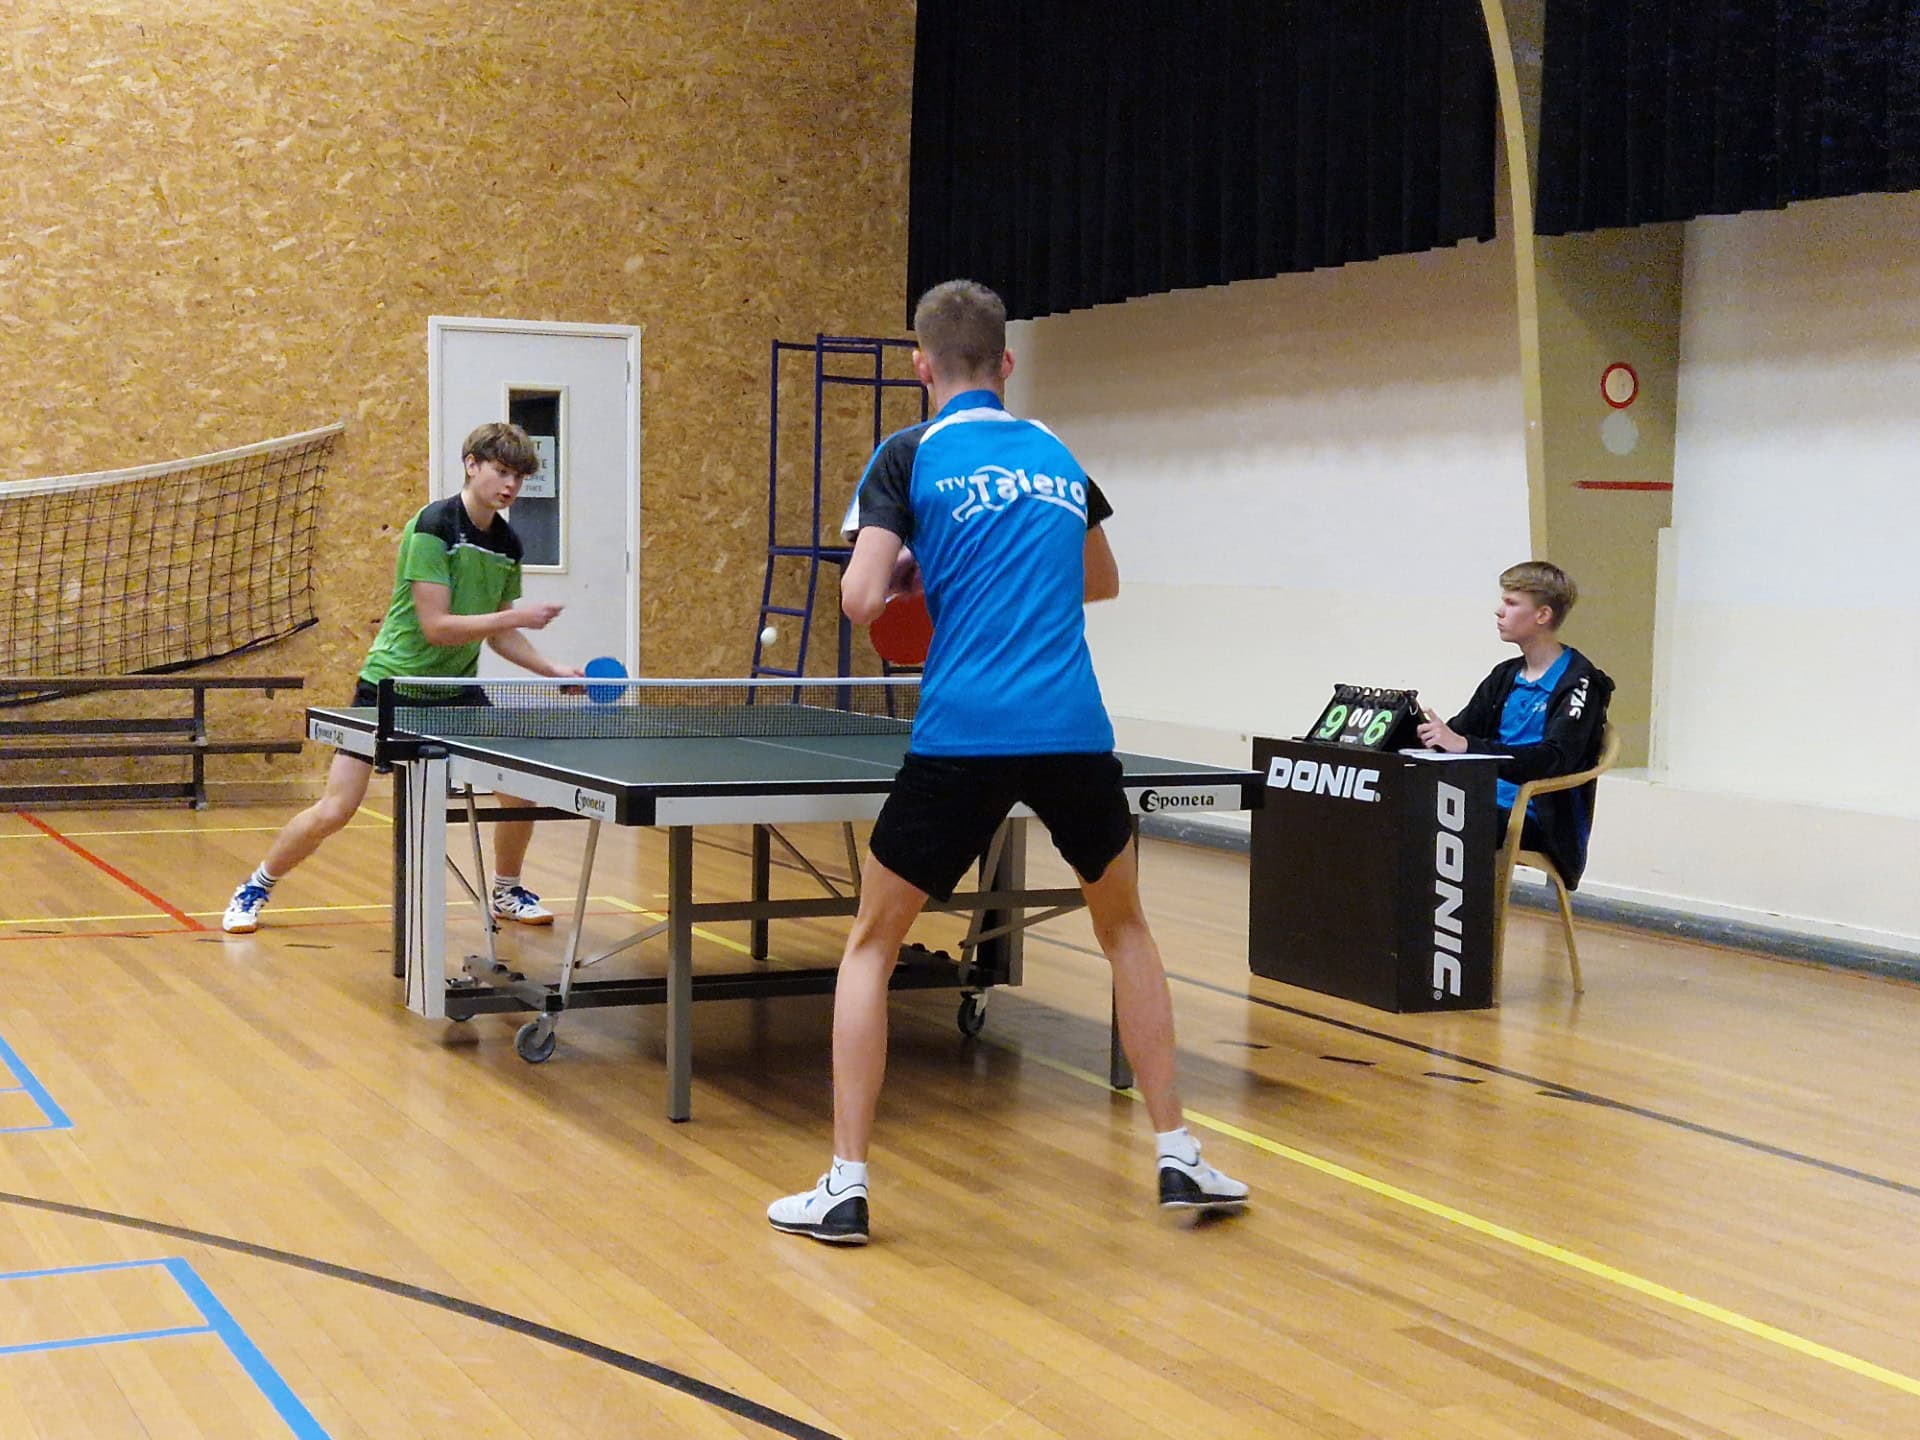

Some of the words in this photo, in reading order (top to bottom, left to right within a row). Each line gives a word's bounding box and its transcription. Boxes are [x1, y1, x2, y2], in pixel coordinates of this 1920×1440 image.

[935, 475, 967, 493] TTV
[968, 468, 1088, 506] Talero
[1319, 704, 1348, 739] 9
[1363, 709, 1393, 746] 6
[1138, 789, 1215, 813] Sponeta
